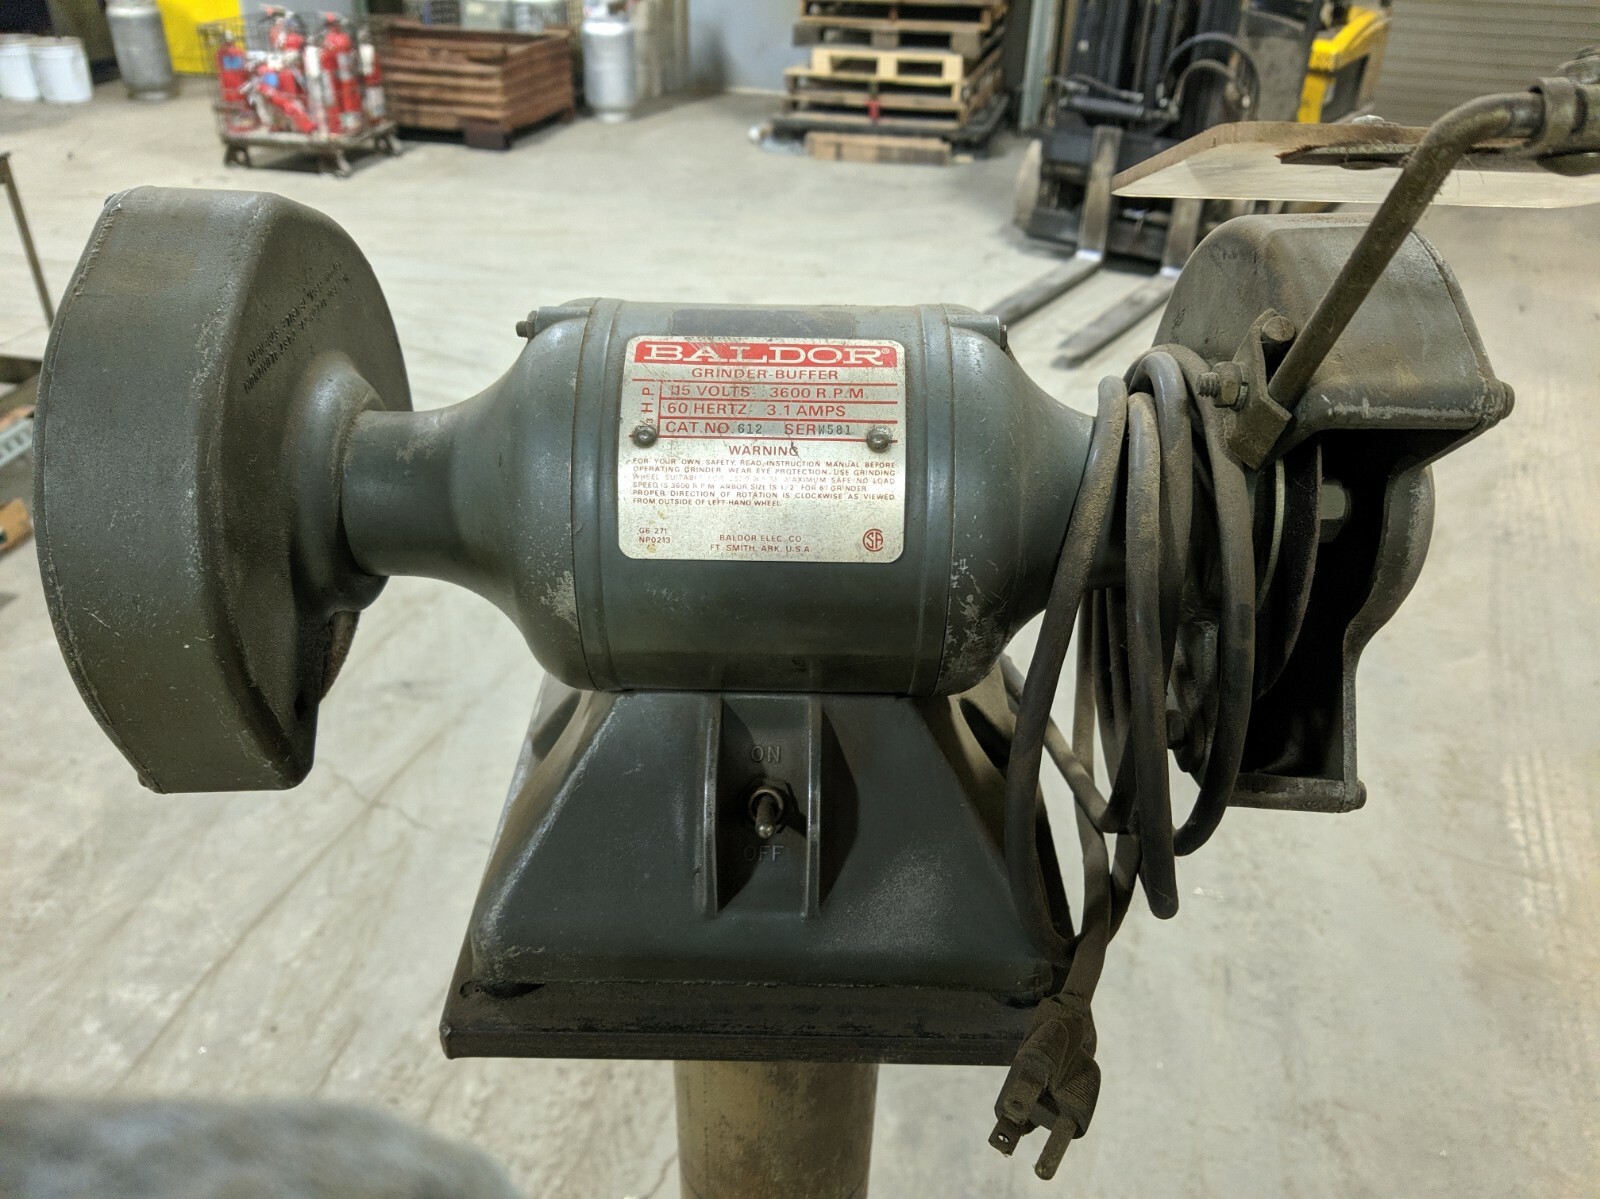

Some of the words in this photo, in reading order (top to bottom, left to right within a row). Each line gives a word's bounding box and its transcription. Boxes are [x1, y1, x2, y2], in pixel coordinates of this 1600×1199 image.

[691, 367, 839, 380] GRINDER-BUFFER
[670, 385, 691, 396] 115
[696, 385, 751, 397] VOLTS
[769, 387, 811, 399] 3600
[667, 402, 688, 414] 60
[693, 402, 747, 415] HERTZ
[766, 404, 790, 416] 3.1
[796, 405, 846, 417] AMPS
[737, 423, 763, 435] 612
[728, 445, 799, 457] WARNING
[853, 469, 896, 477] GRINDING
[632, 489, 666, 497] PROPER
[670, 490, 716, 498] DIRECTION
[736, 491, 779, 499] ROTATION
[863, 493, 896, 501] VIEWED
[751, 745, 781, 762] ON
[743, 844, 785, 861] OFF
